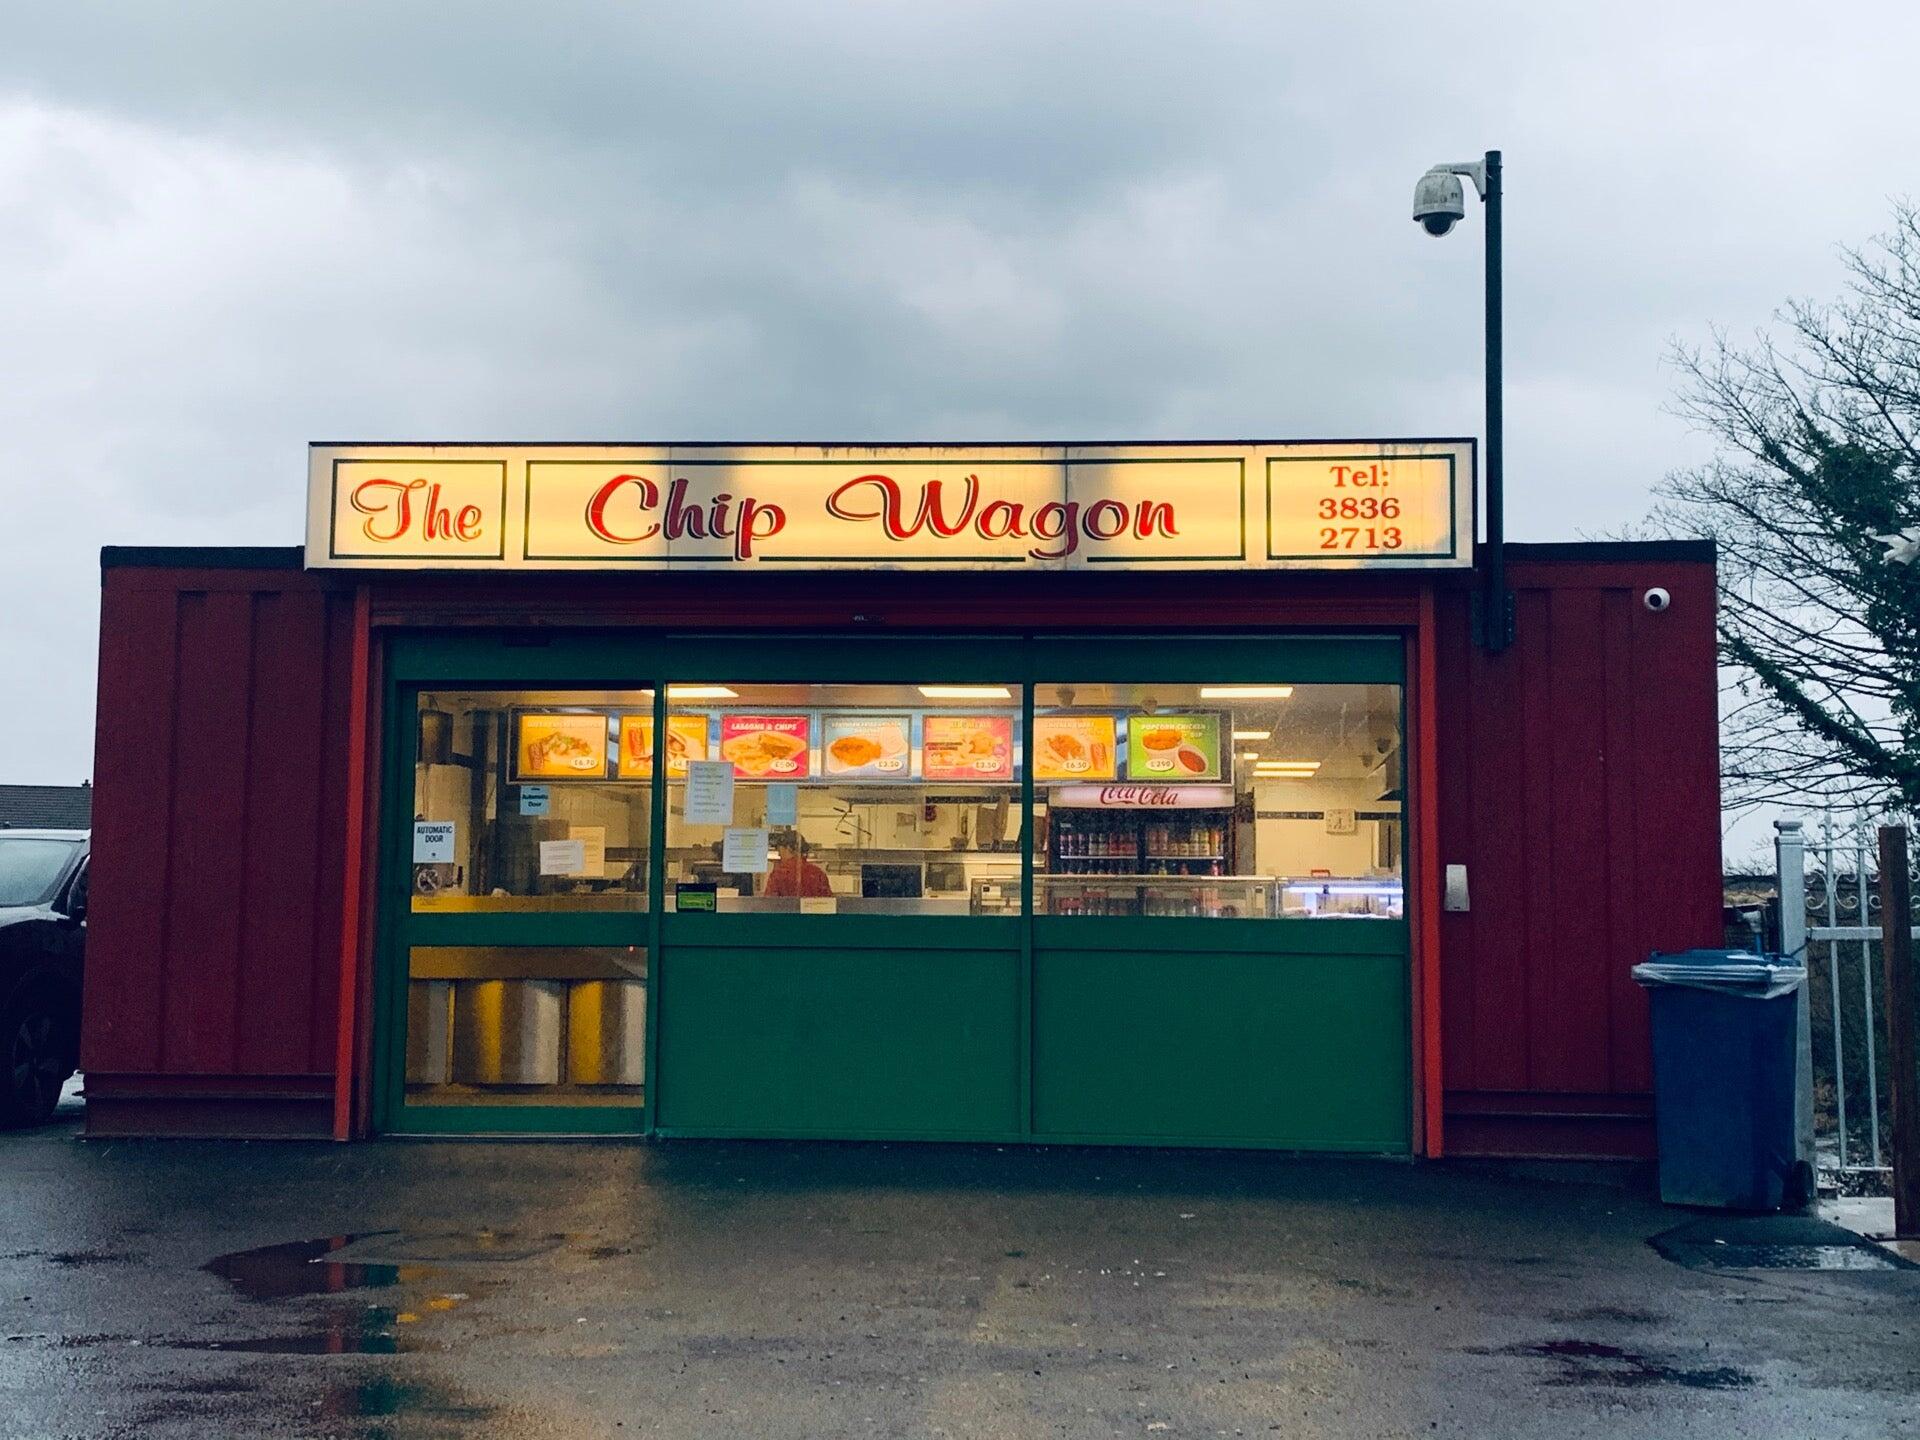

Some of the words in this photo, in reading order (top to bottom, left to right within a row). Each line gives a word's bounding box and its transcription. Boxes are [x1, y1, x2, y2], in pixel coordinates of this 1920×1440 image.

[1330, 465, 1389, 487] Tel:
[350, 478, 483, 544] The
[585, 473, 787, 561] Chip
[825, 473, 1180, 559] Wagon
[1318, 496, 1400, 520] 3836
[1319, 526, 1402, 550] 2713
[774, 722, 797, 731] CHIPS
[417, 825, 453, 834] AUTOMATIC
[425, 834, 444, 843] DOOR
